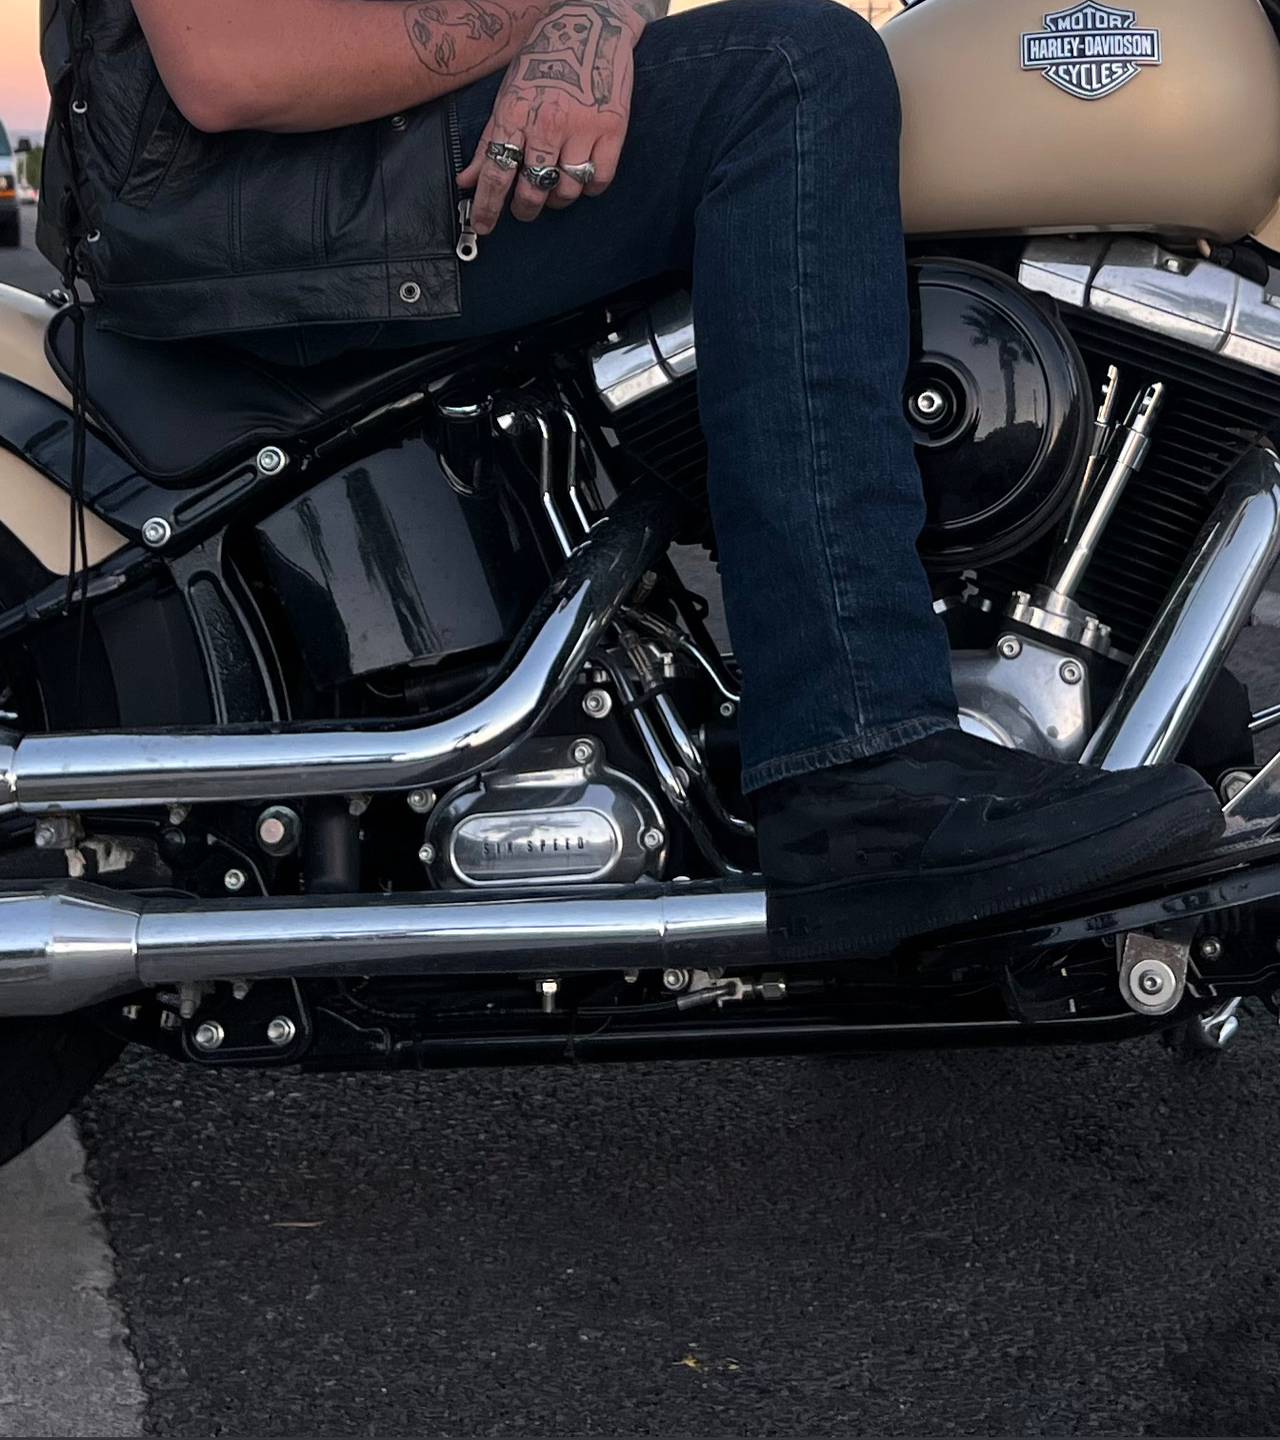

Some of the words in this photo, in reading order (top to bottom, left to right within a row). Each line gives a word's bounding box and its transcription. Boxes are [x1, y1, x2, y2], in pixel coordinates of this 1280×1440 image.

[1058, 8, 1122, 30] MOTOR
[1030, 35, 1152, 60] HARLEY-DAVIDSON
[1058, 63, 1124, 90] CYCLES
[483, 839, 513, 856] SIX
[527, 836, 585, 853] SPEED
